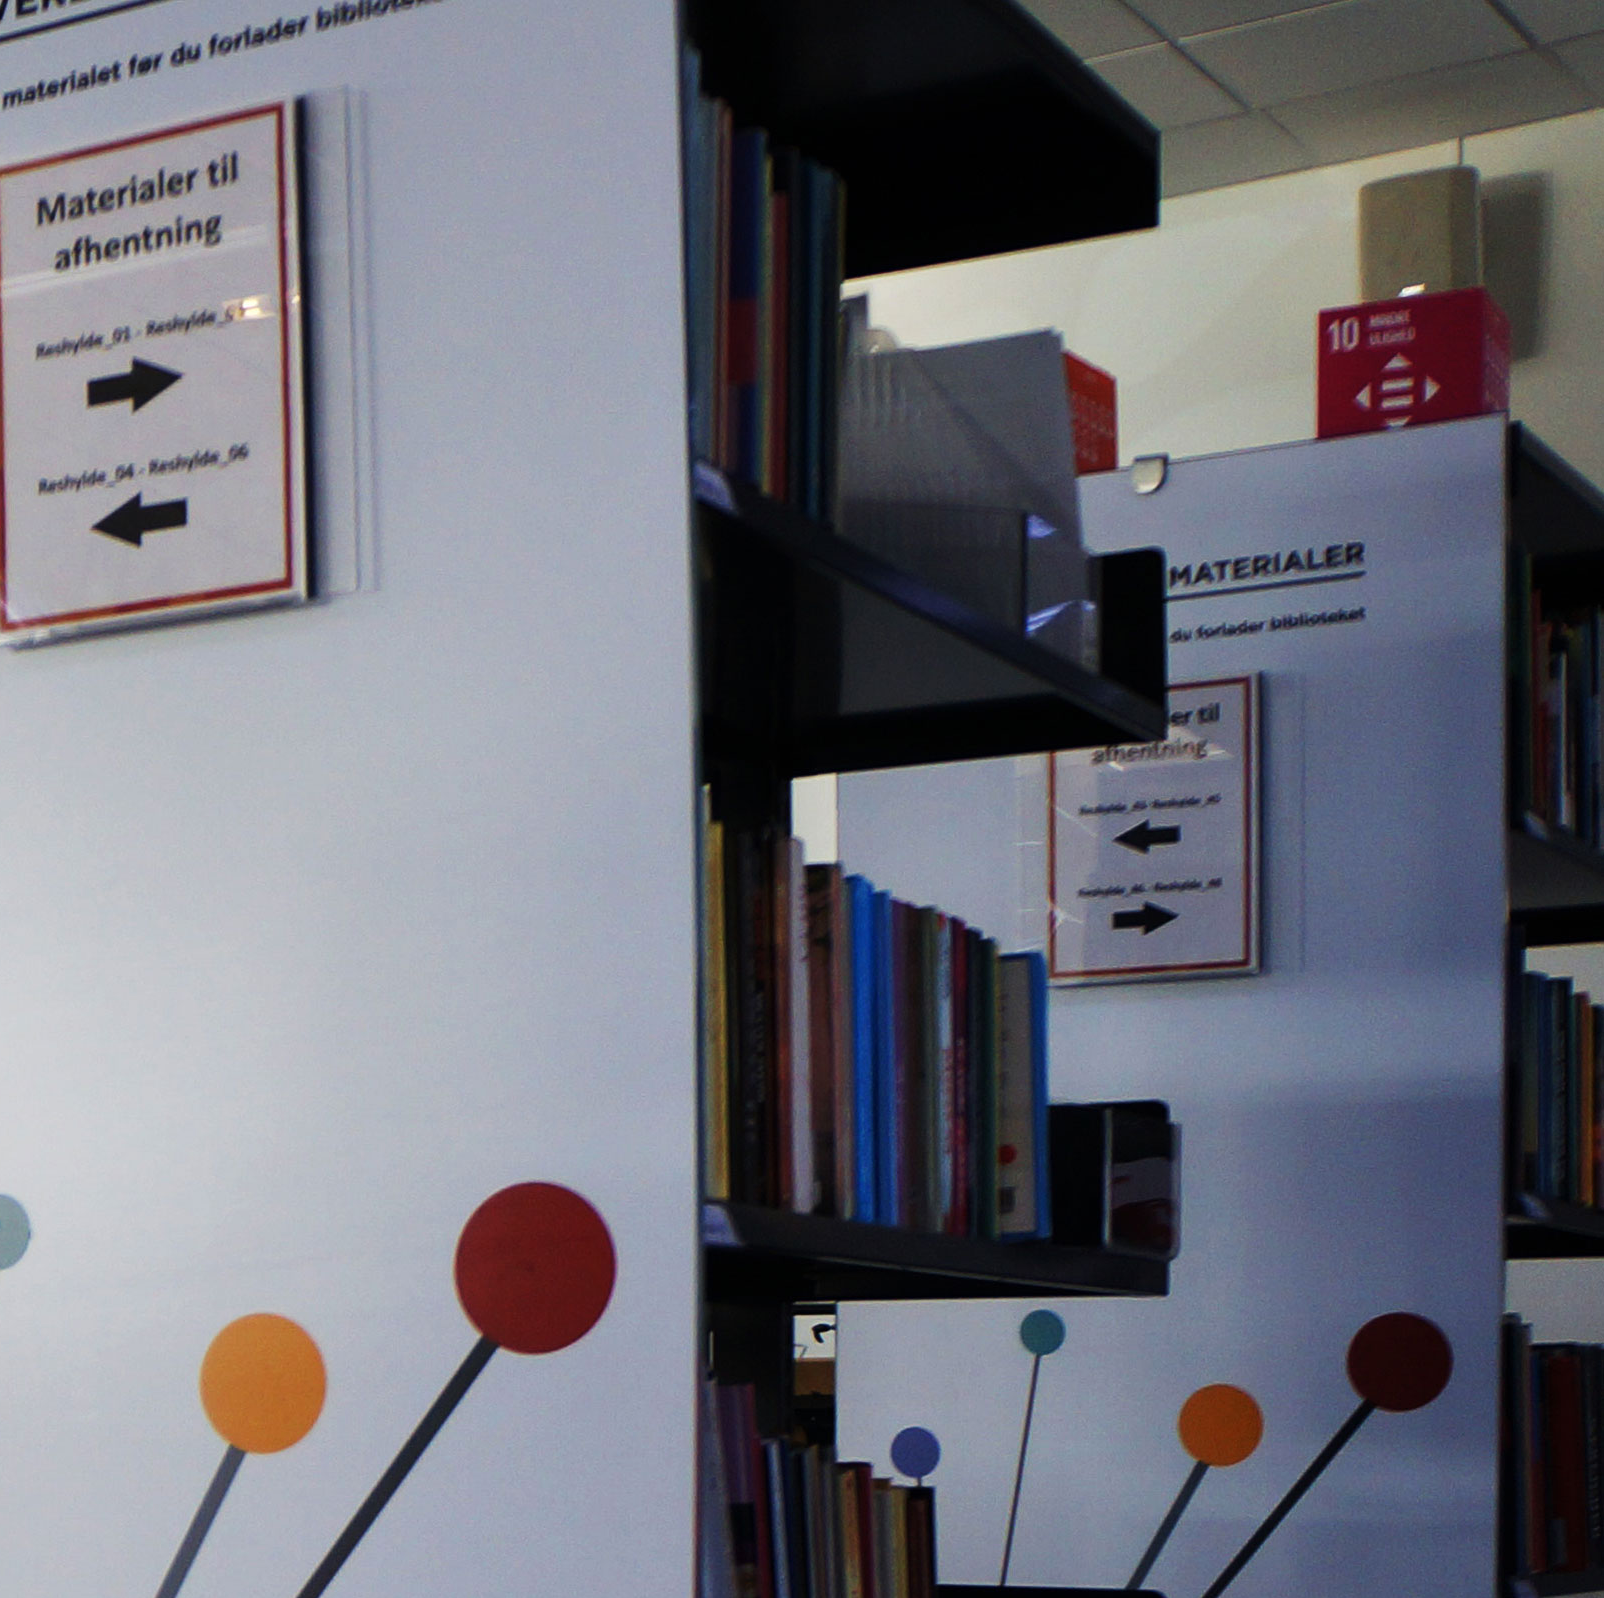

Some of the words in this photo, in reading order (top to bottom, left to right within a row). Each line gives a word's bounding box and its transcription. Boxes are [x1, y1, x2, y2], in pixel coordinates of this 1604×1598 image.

[2, 61, 121, 109] materialet
[128, 50, 162, 78] før
[171, 43, 199, 68] du
[208, 15, 309, 59] forlader
[36, 166, 199, 226] Materialer
[207, 150, 239, 189] til
[54, 213, 223, 272] afhentning
[1327, 315, 1360, 352] 10
[1169, 541, 1366, 589] MATERIALER
[1170, 627, 1192, 644] du
[1196, 620, 1265, 640] forlader
[1270, 606, 1366, 632] biblioteket
[1197, 702, 1220, 724] til
